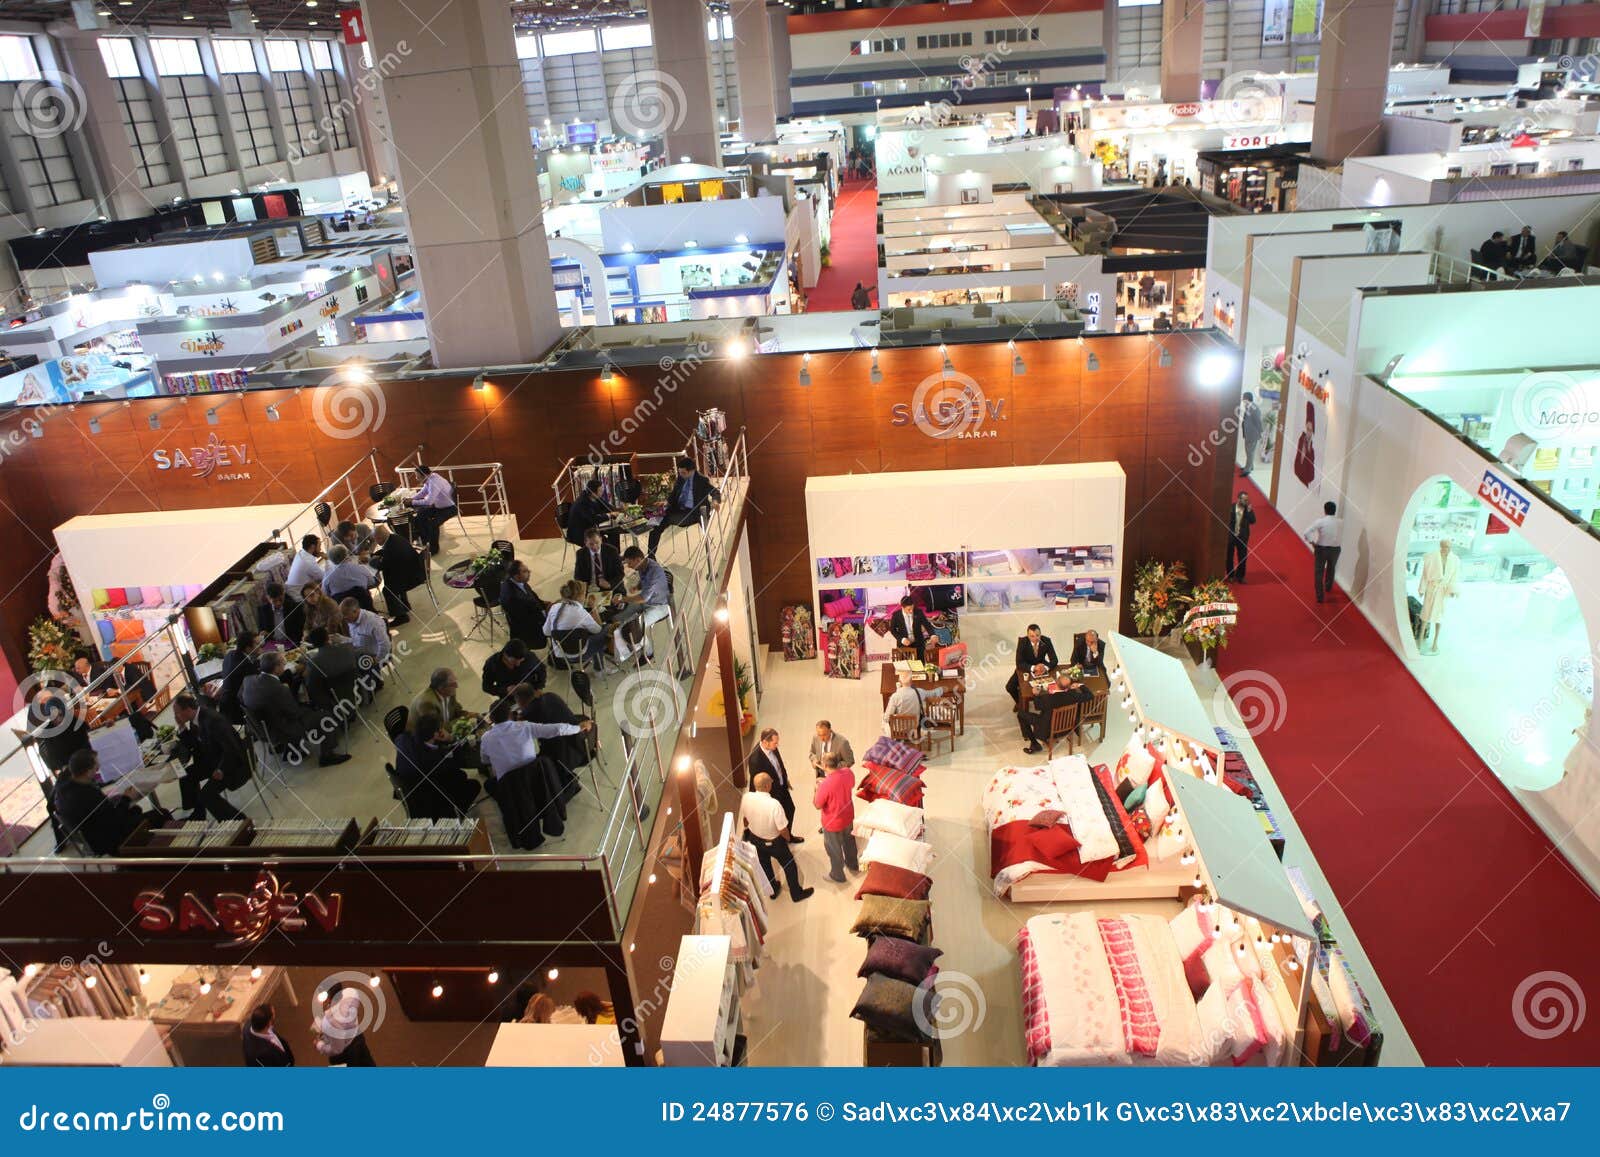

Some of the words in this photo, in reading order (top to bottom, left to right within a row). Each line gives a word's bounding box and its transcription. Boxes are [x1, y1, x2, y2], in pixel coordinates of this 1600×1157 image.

[346, 18, 361, 38] 1
[1171, 103, 1200, 117] hobby
[957, 430, 998, 440] SARAR
[1481, 475, 1528, 520] SOLEY
